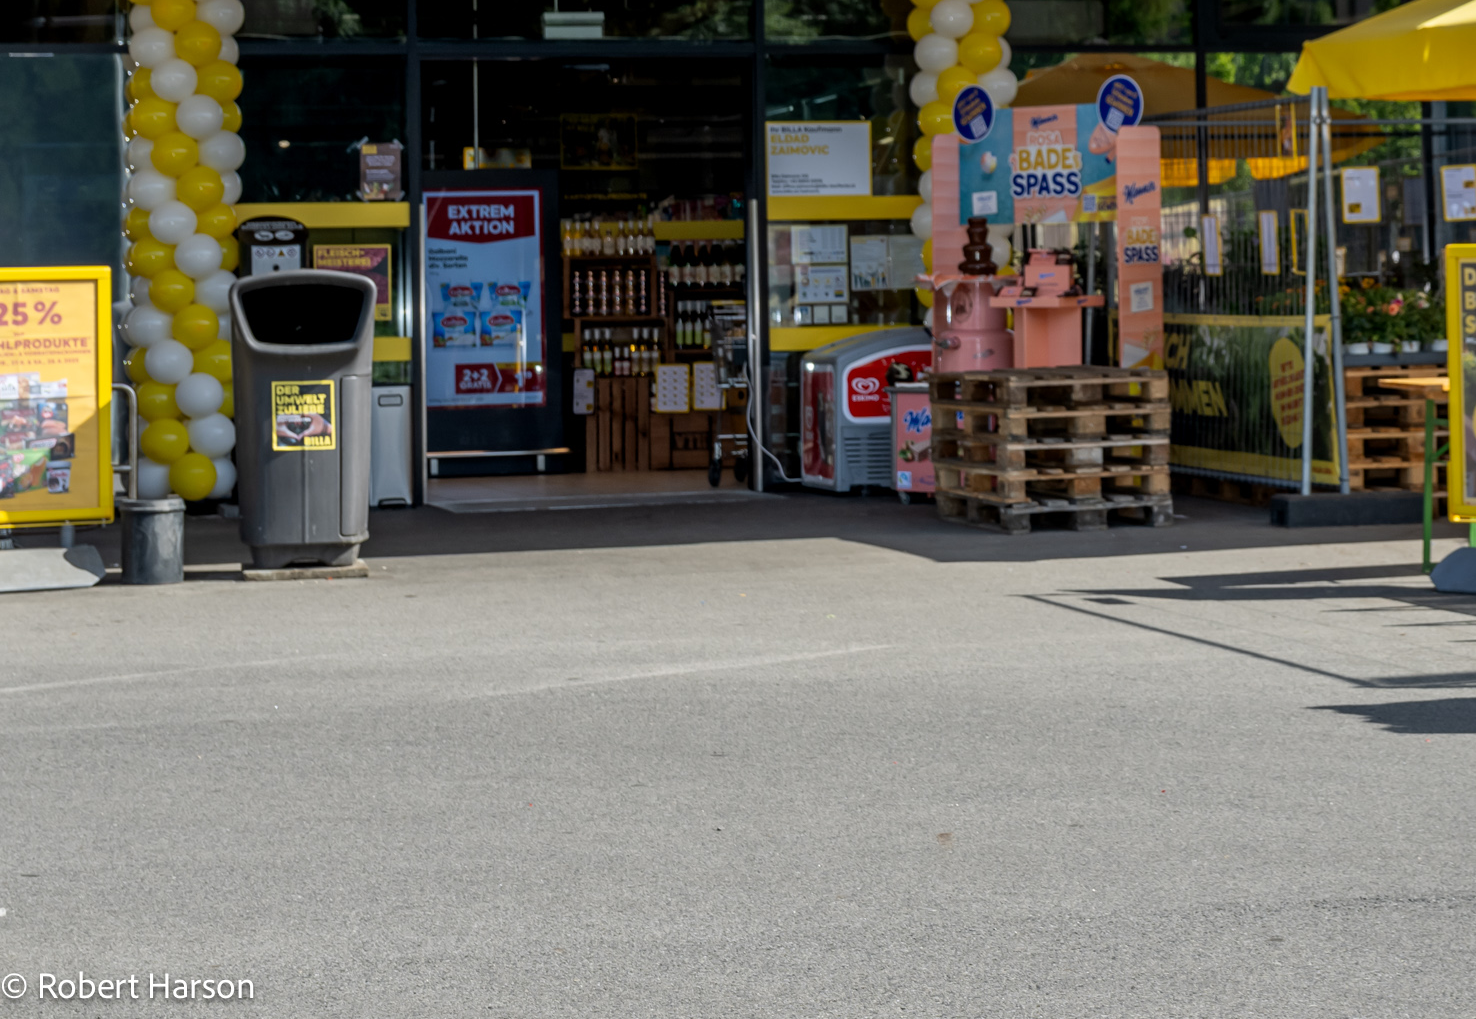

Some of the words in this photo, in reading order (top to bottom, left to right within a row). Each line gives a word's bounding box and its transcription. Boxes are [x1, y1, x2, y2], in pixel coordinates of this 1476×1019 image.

[770, 134, 810, 144] ELDAD
[1018, 147, 1074, 172] BADE
[1012, 172, 1080, 197] SPASS
[447, 204, 515, 220] EXTREM
[448, 220, 515, 236] AKTION
[1126, 228, 1157, 245] BADE
[1124, 245, 1159, 263] SPASS
[276, 385, 300, 395] DER
[276, 393, 326, 405] UMWELT
[277, 404, 325, 415] ZULIEBE
[304, 435, 331, 446] BILLA
